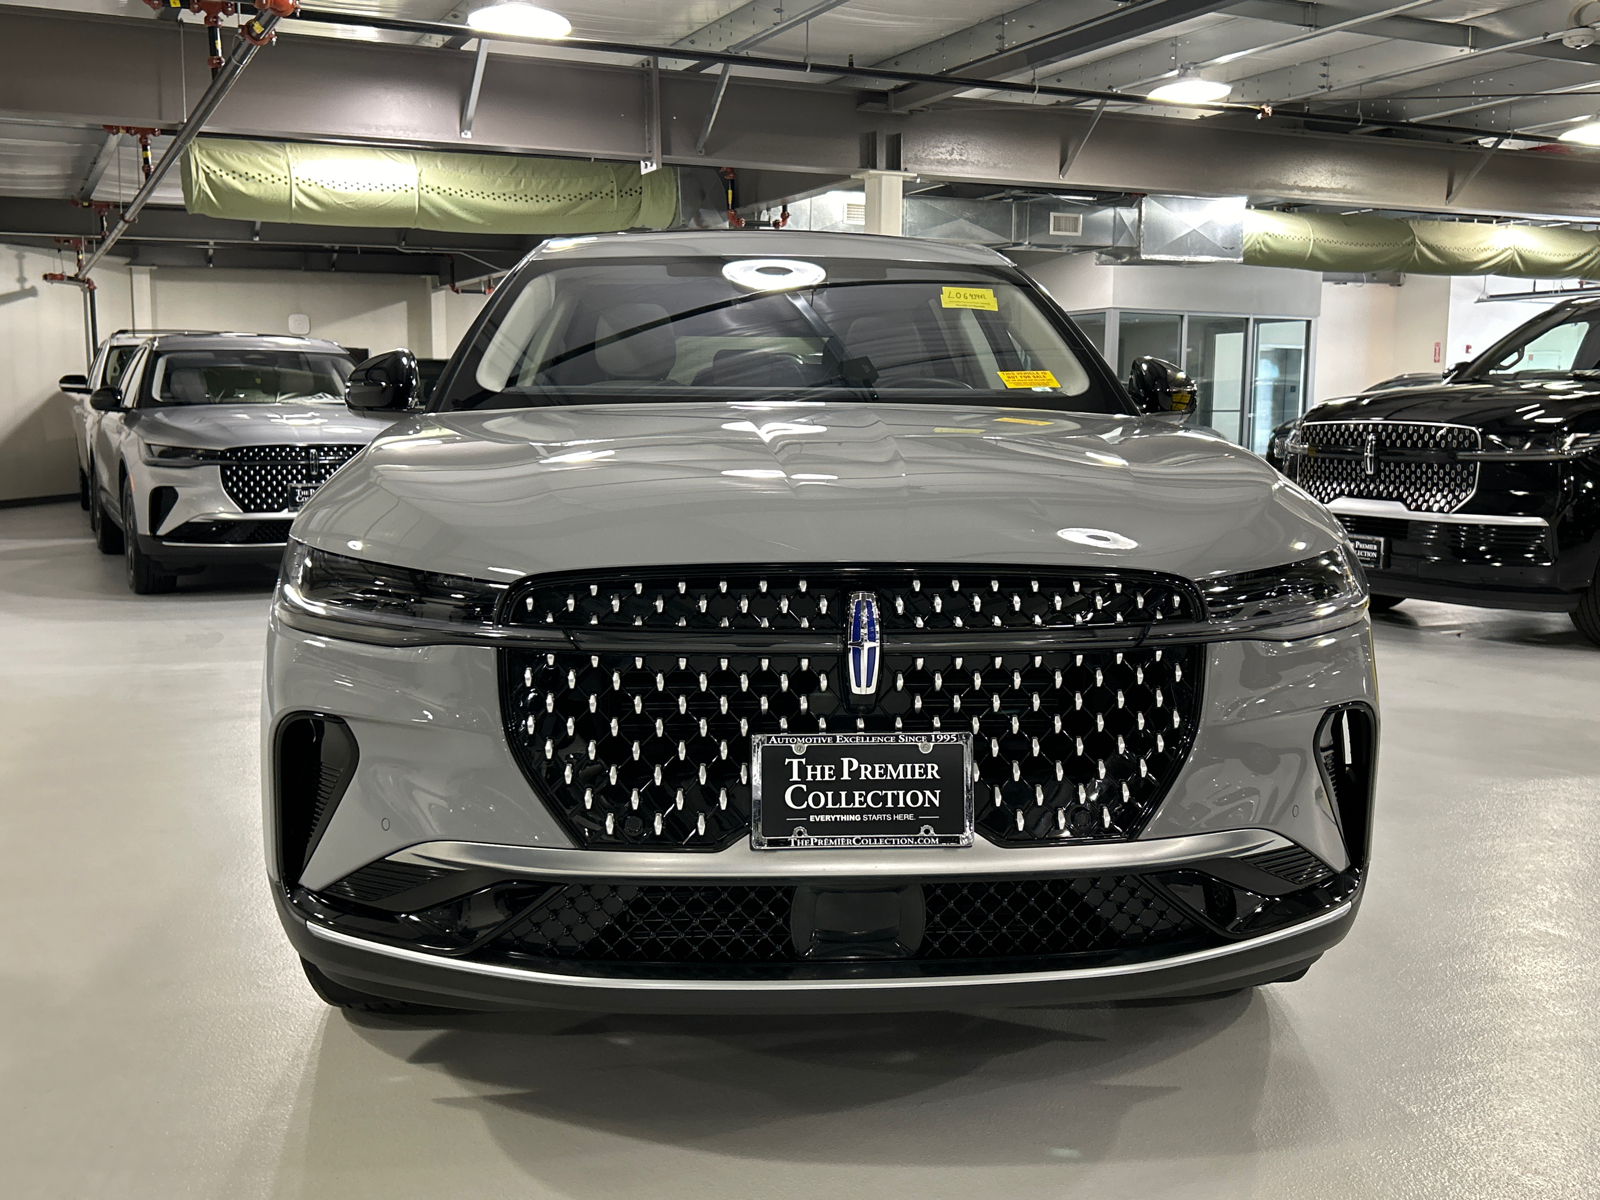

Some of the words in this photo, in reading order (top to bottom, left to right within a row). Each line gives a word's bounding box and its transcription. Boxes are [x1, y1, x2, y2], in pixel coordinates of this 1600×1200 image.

[931, 734, 957, 743] 1995
[809, 814, 861, 822] EVERYTHING
[862, 813, 892, 821] STARTS
[893, 813, 916, 821] HERE.
